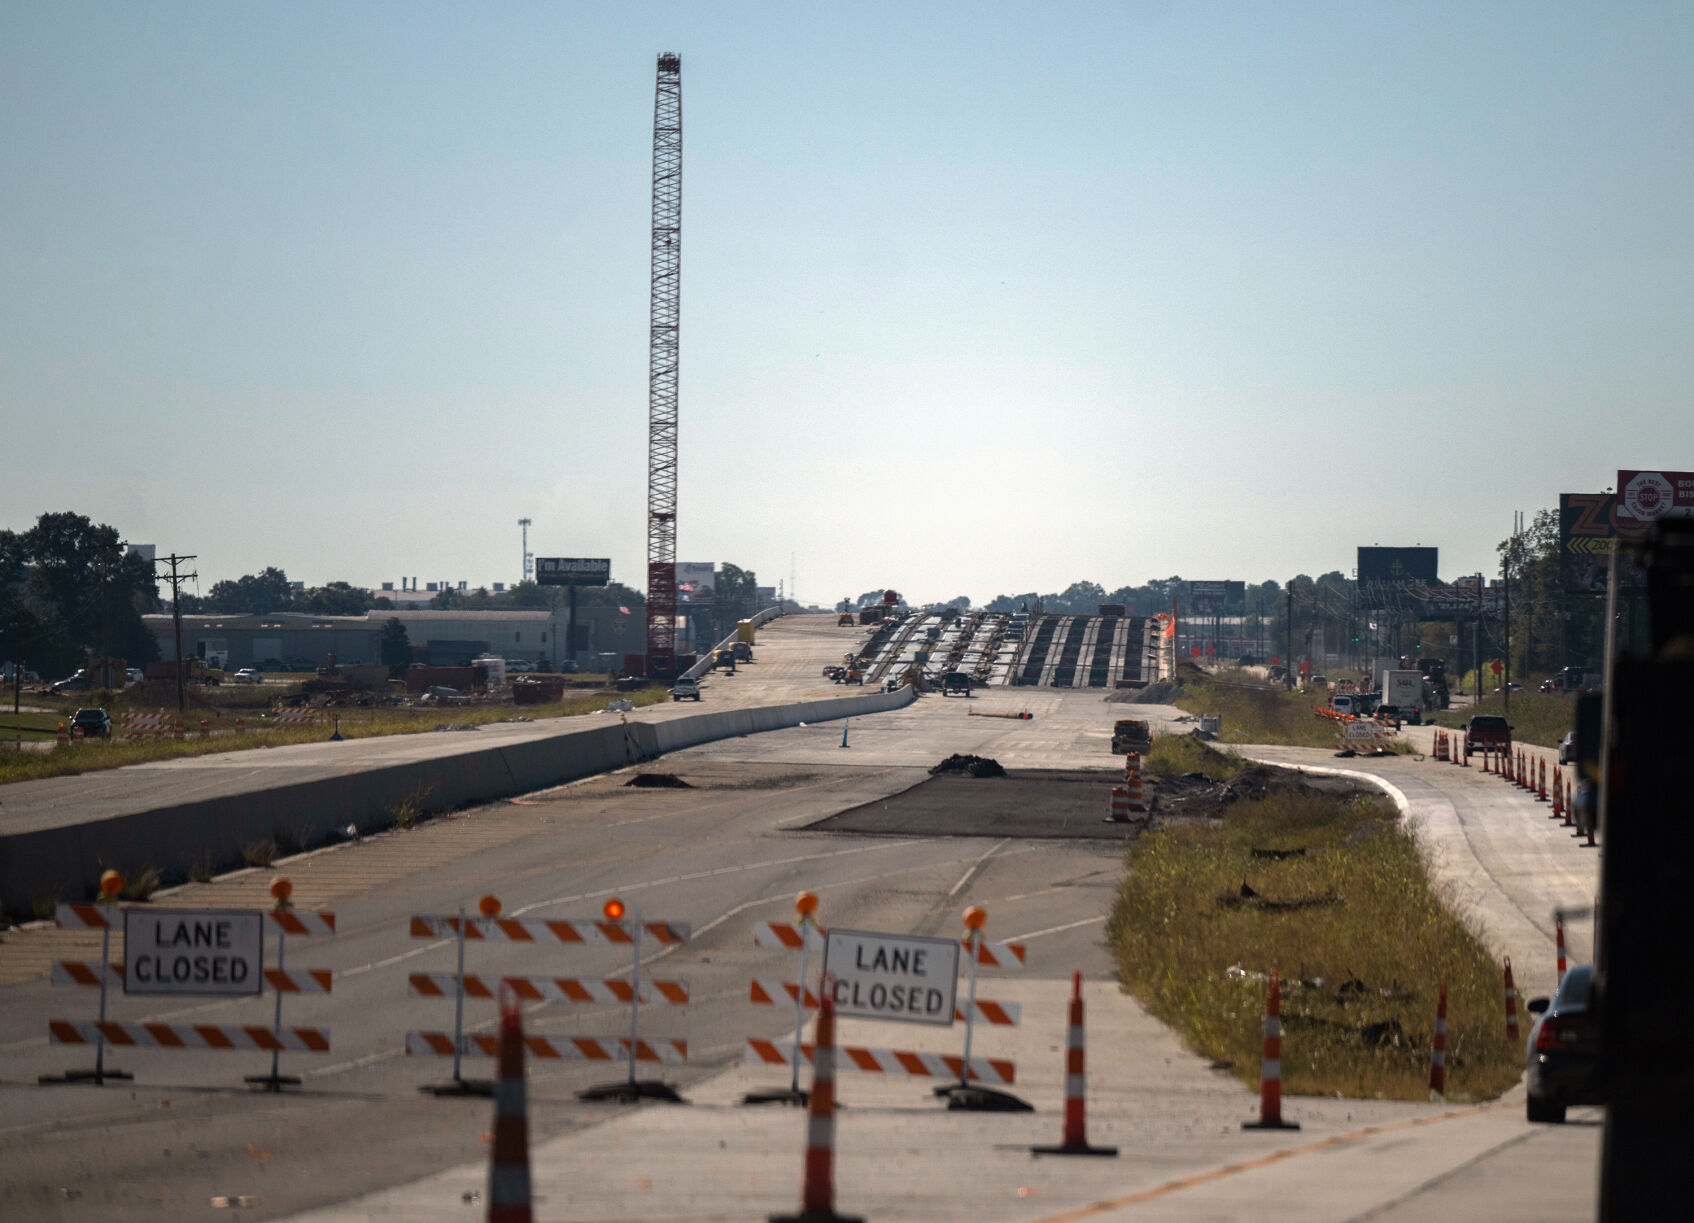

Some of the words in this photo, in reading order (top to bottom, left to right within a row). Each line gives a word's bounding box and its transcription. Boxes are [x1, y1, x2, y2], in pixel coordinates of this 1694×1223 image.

[1639, 492, 1657, 502] STOP
[538, 559, 555, 571] I'm
[558, 559, 608, 571] Available
[156, 920, 232, 948] LANE
[135, 955, 248, 984] CLOSED
[856, 944, 928, 977] LANE
[832, 978, 943, 1016] CLOSED
